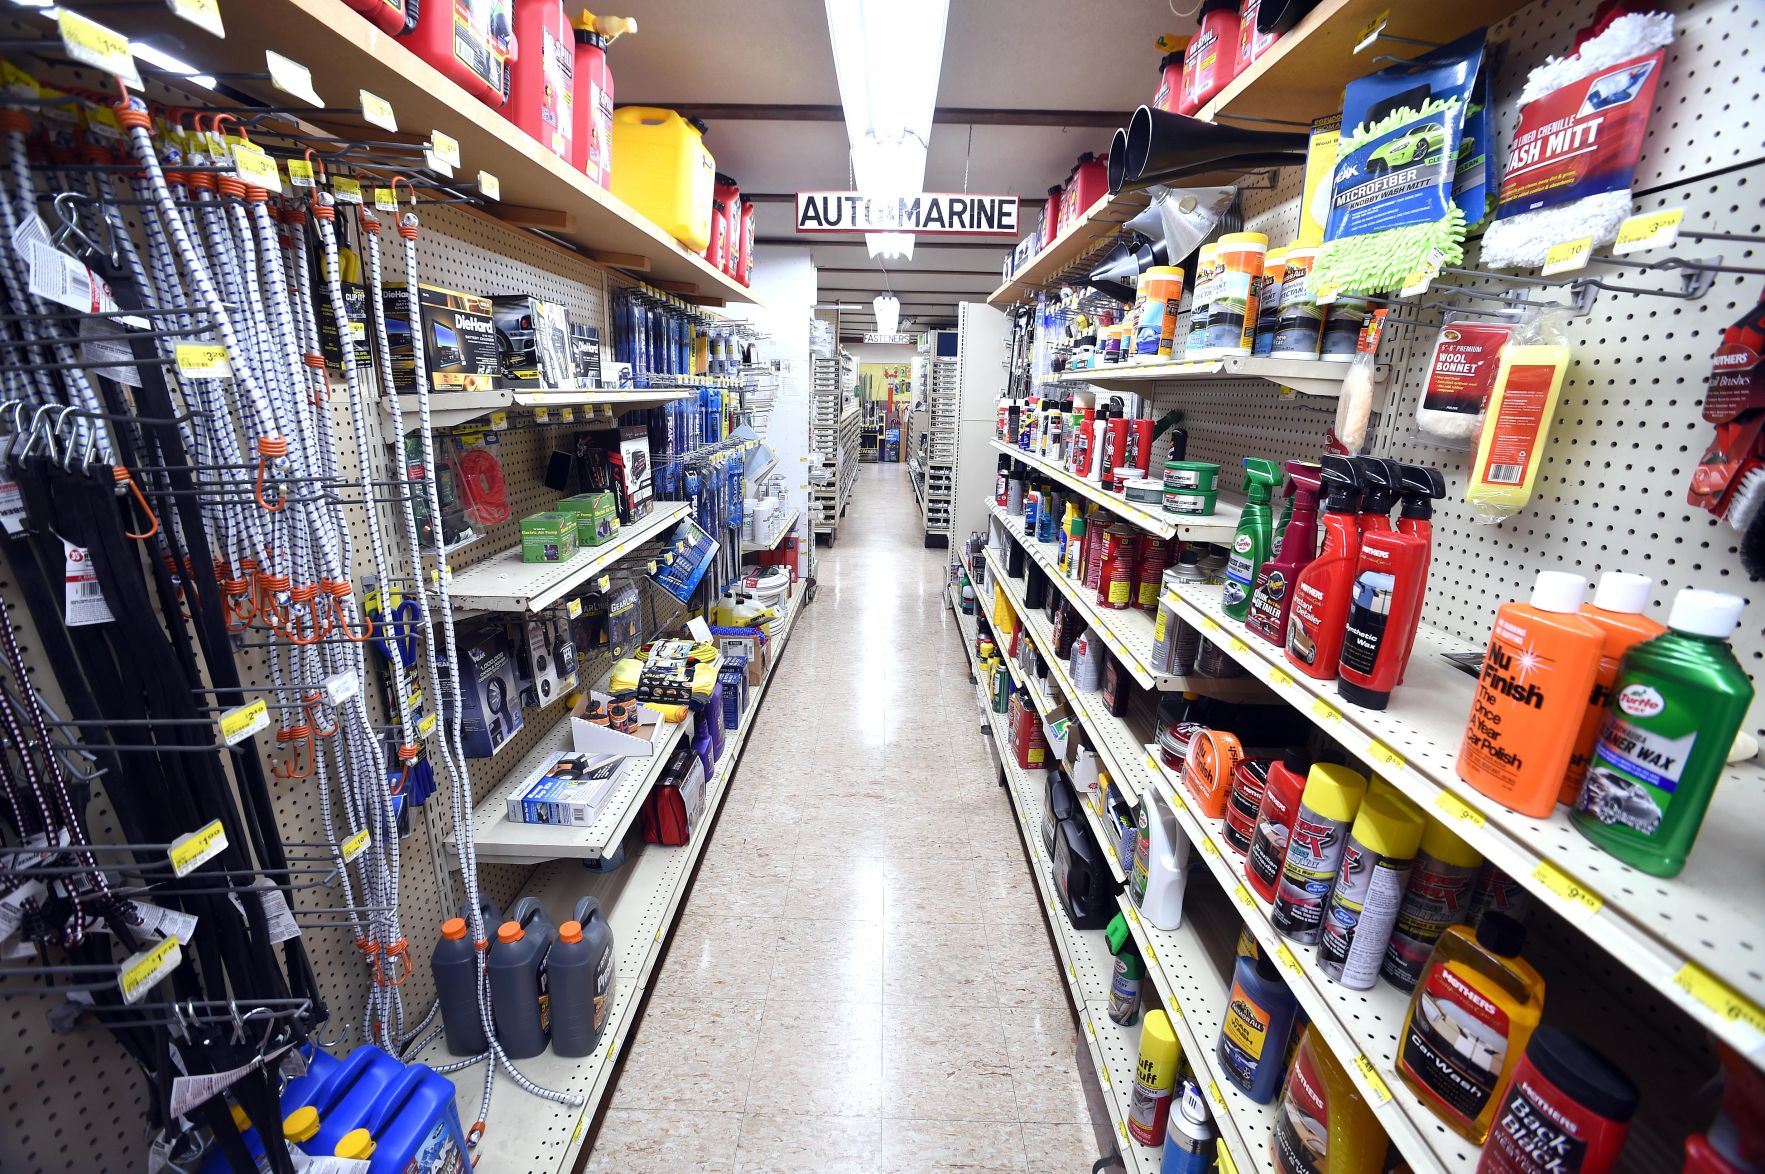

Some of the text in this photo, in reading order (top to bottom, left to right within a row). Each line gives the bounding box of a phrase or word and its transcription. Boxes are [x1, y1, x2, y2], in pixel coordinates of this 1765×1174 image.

[1518, 130, 1537, 147] LINED
[1537, 114, 1577, 139] CHENILLE
[1545, 117, 1604, 158] MITT
[1335, 169, 1417, 208] MICROFIBER
[1349, 178, 1432, 210] KNOBBY WASH MITT
[898, 197, 1017, 230] MARINE
[455, 314, 494, 334] DieHard
[864, 333, 910, 343] FASTENERS
[1456, 345, 1482, 353] PREMIUM
[1436, 362, 1478, 374] BONNET
[1439, 353, 1466, 363] WOOL
[1361, 545, 1390, 559] MOTHERS
[1255, 598, 1281, 619] DETAILER
[1296, 605, 1322, 626] Detailer
[1356, 637, 1376, 650] Wax
[1488, 641, 1512, 671] Nu
[1479, 684, 1497, 706] The
[1482, 663, 1545, 710] Finish
[1474, 699, 1502, 725] Once
[1620, 692, 1659, 710] Turtle
[1469, 713, 1502, 741] A Year
[1465, 727, 1523, 771] Car Polish
[1636, 746, 1676, 772] WAX
[1441, 968, 1497, 1015] MOTHERS
[1231, 1020, 1253, 1046] WASH
[1234, 1016, 1250, 1036] CAR
[1138, 1058, 1154, 1073] uff
[1522, 1080, 1578, 1134] MOTHERS
[1510, 1096, 1571, 1156] Back
[1501, 1113, 1567, 1174] Black
